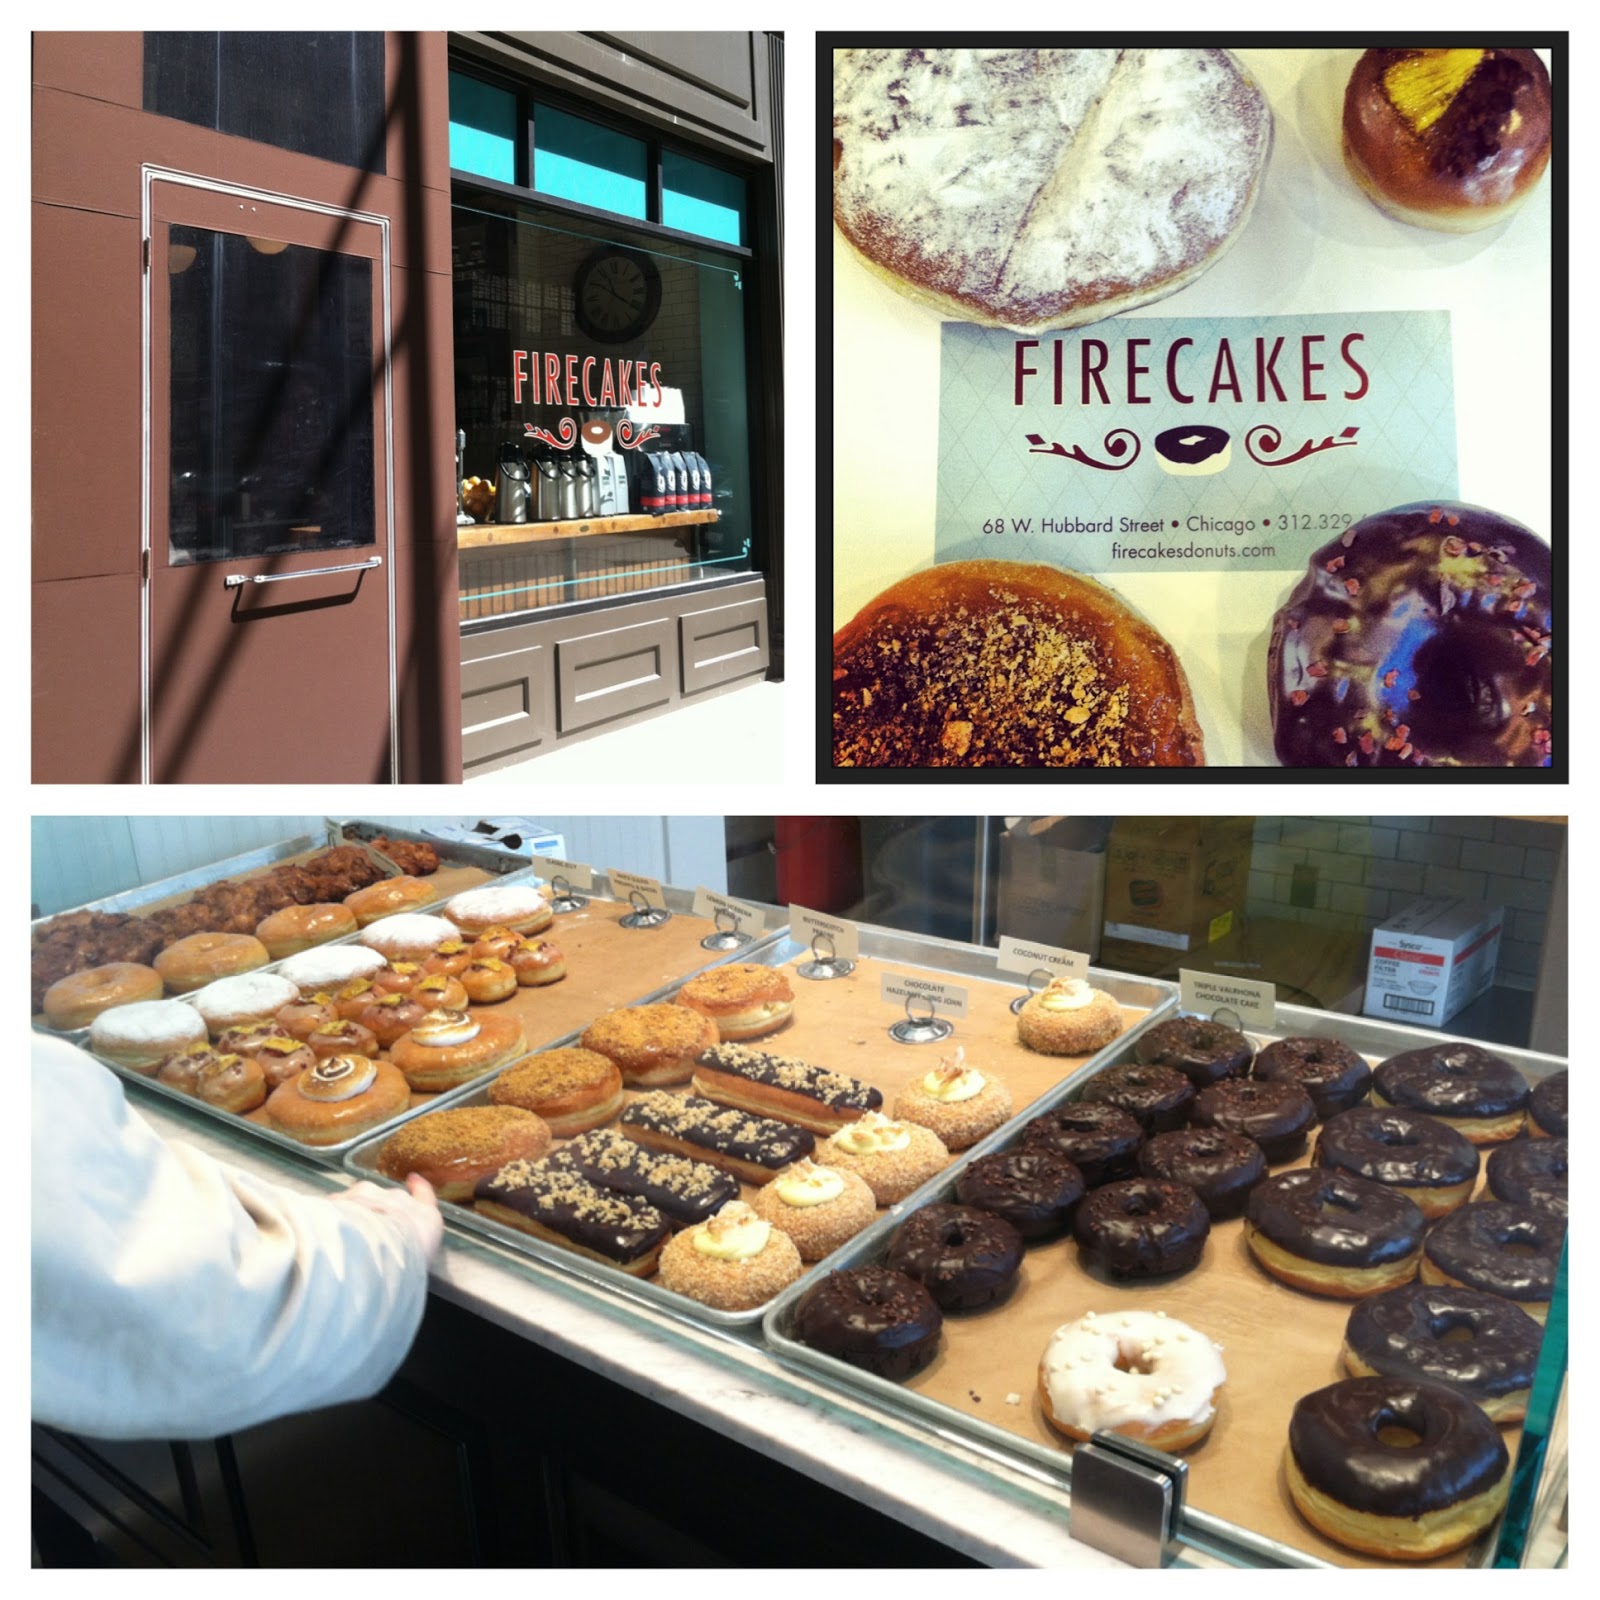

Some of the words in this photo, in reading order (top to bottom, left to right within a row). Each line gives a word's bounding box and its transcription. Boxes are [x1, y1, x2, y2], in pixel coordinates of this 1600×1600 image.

[1013, 333, 1370, 406] FIRECAKES
[513, 350, 662, 408] FIRECAKES
[982, 518, 1005, 534] 68
[1011, 518, 1034, 534] W.
[1041, 516, 1113, 533] Hubbard
[1119, 516, 1164, 533] Street
[1186, 515, 1256, 536] Chicago
[1112, 541, 1276, 559] firecakesdonuts.com
[1013, 948, 1048, 961] COCONUT
[1048, 956, 1074, 967] CREAM
[904, 980, 944, 992] CHOCOLATE
[1194, 981, 1217, 991] TRIPLE
[1218, 986, 1261, 998] VALRHONA
[1195, 992, 1238, 1005] CHOCOLATE
[1240, 999, 1259, 1009] CAKE
